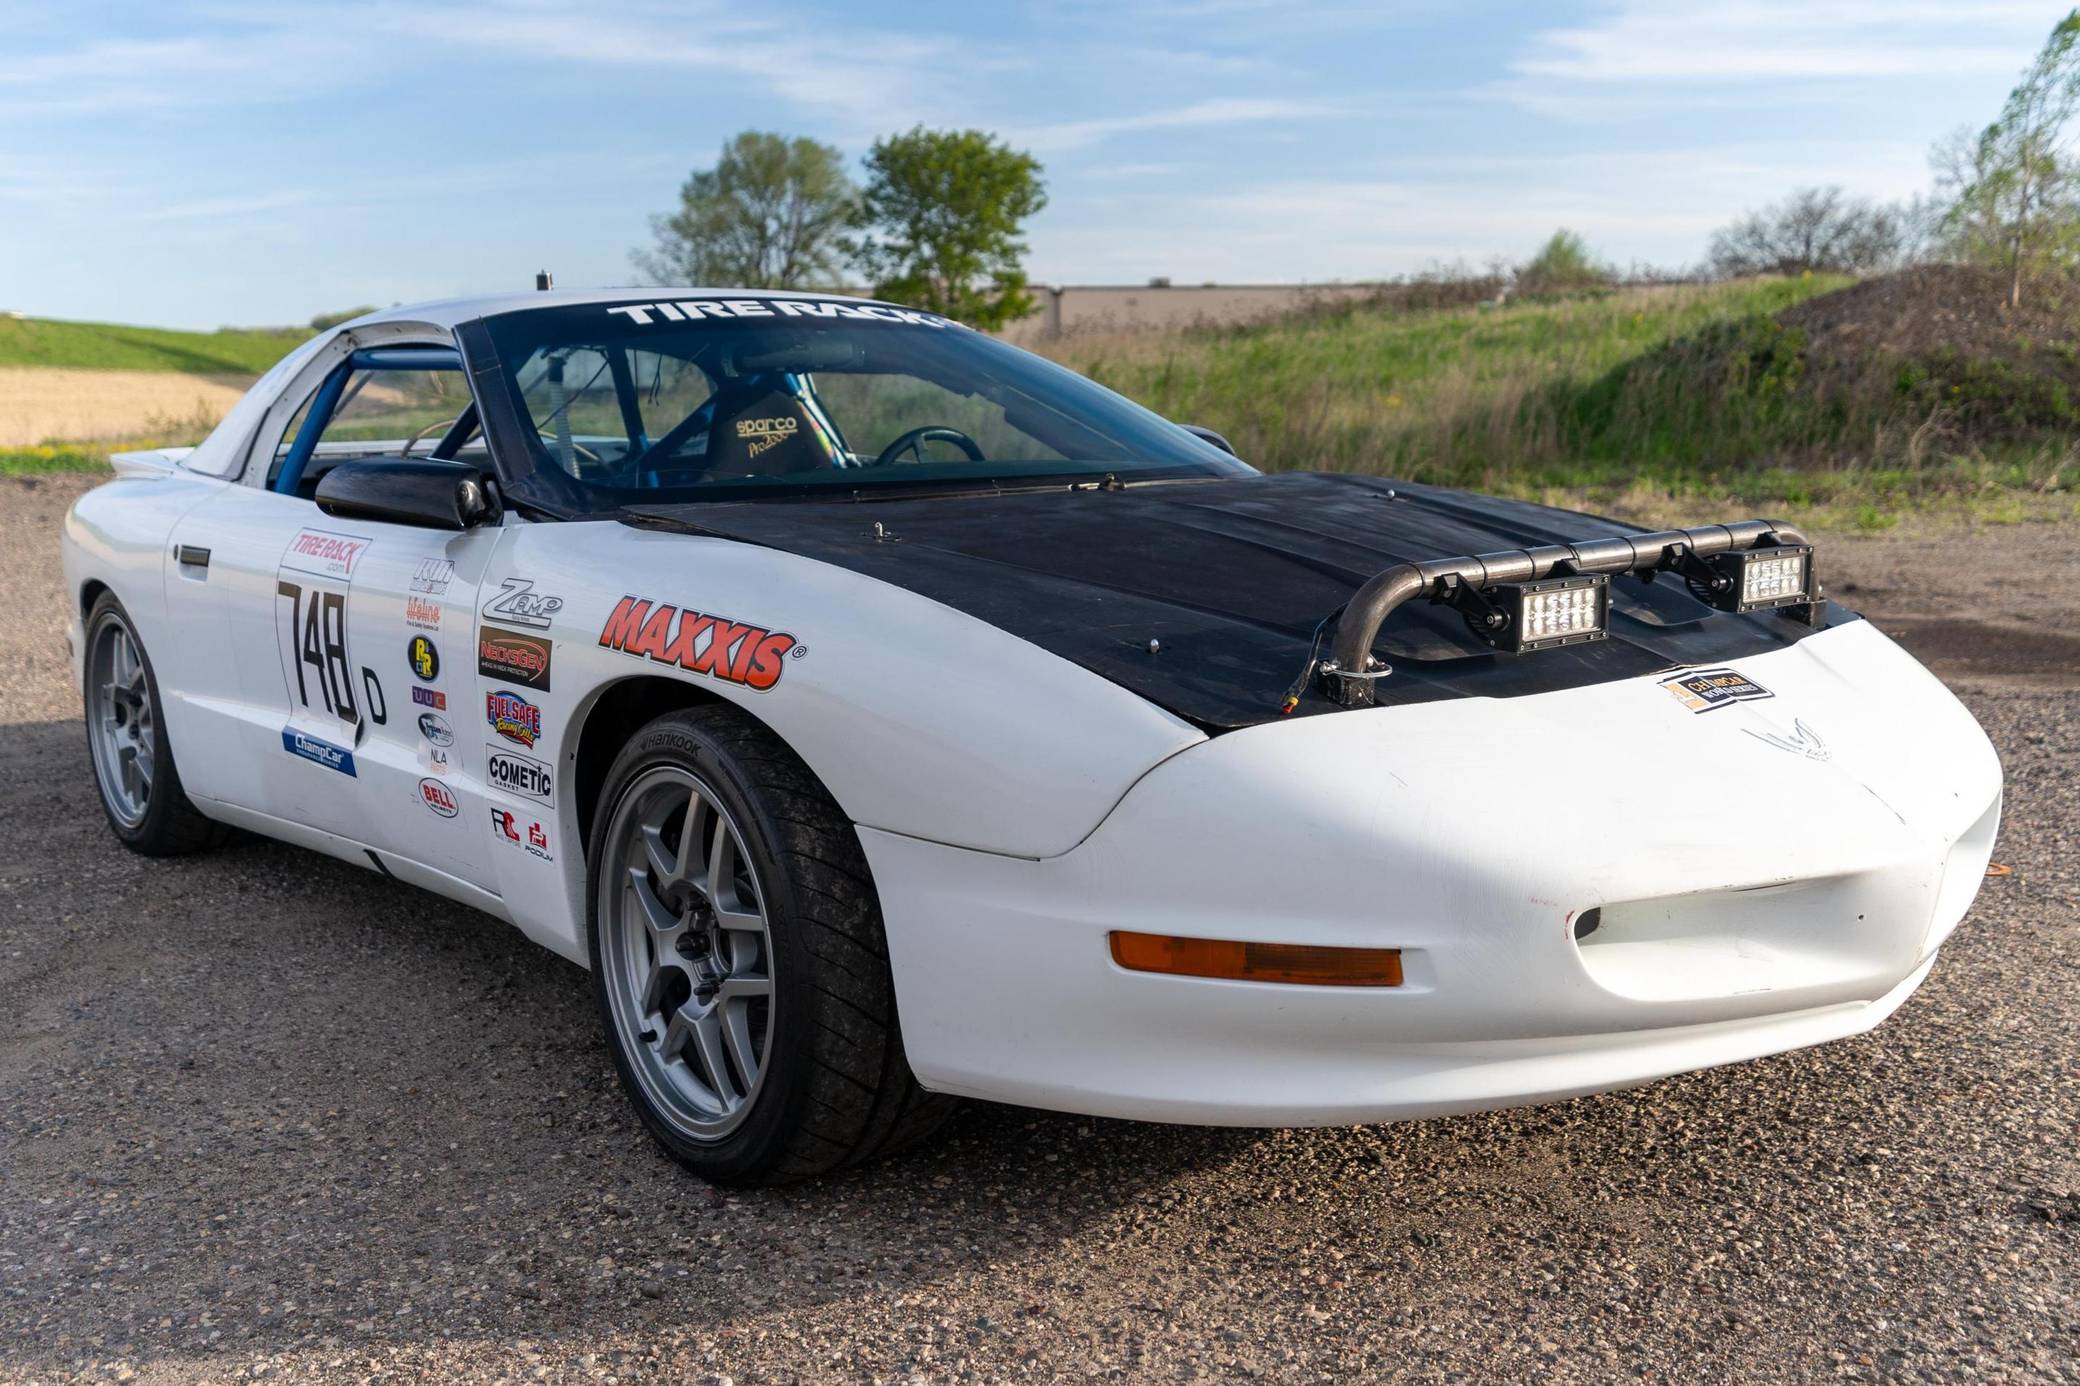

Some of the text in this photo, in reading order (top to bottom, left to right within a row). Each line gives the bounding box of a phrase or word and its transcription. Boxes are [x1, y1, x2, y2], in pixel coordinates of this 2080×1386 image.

[606, 300, 945, 329] TIRE RACK
[736, 417, 797, 437] sparco
[278, 580, 357, 725] 748
[599, 595, 797, 690] MAXXIS
[362, 666, 387, 725] D
[486, 694, 540, 735] FUEL SAFE
[295, 733, 343, 763] ChampCar
[431, 748, 448, 765] NLA
[423, 784, 455, 810] BELL
[494, 780, 519, 792] GASKET
[525, 845, 554, 862] PODIUM
